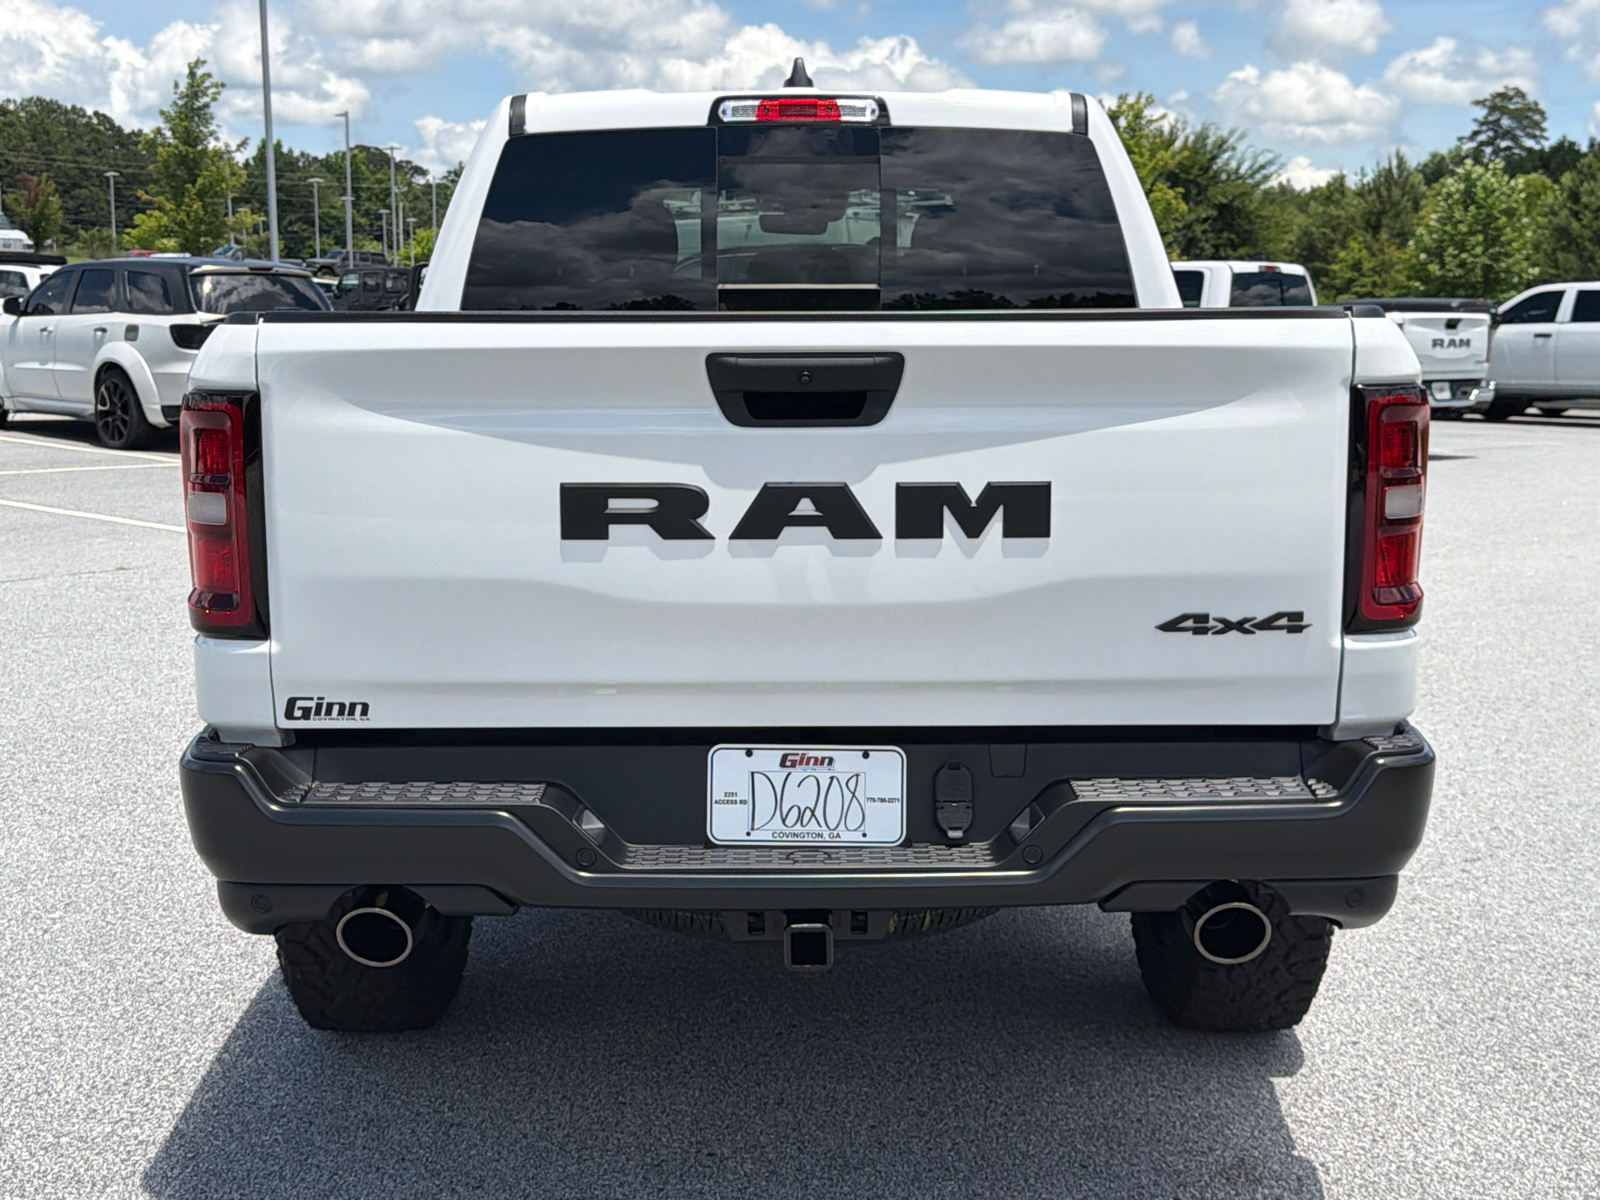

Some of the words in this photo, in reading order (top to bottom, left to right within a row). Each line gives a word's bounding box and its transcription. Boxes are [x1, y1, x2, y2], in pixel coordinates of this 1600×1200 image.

[1431, 338, 1471, 348] RAM
[560, 481, 1052, 540] RAM
[1154, 611, 1313, 635] 4x4
[284, 697, 370, 720] Ginn
[779, 753, 834, 768] Ginn
[751, 771, 865, 831] D6208
